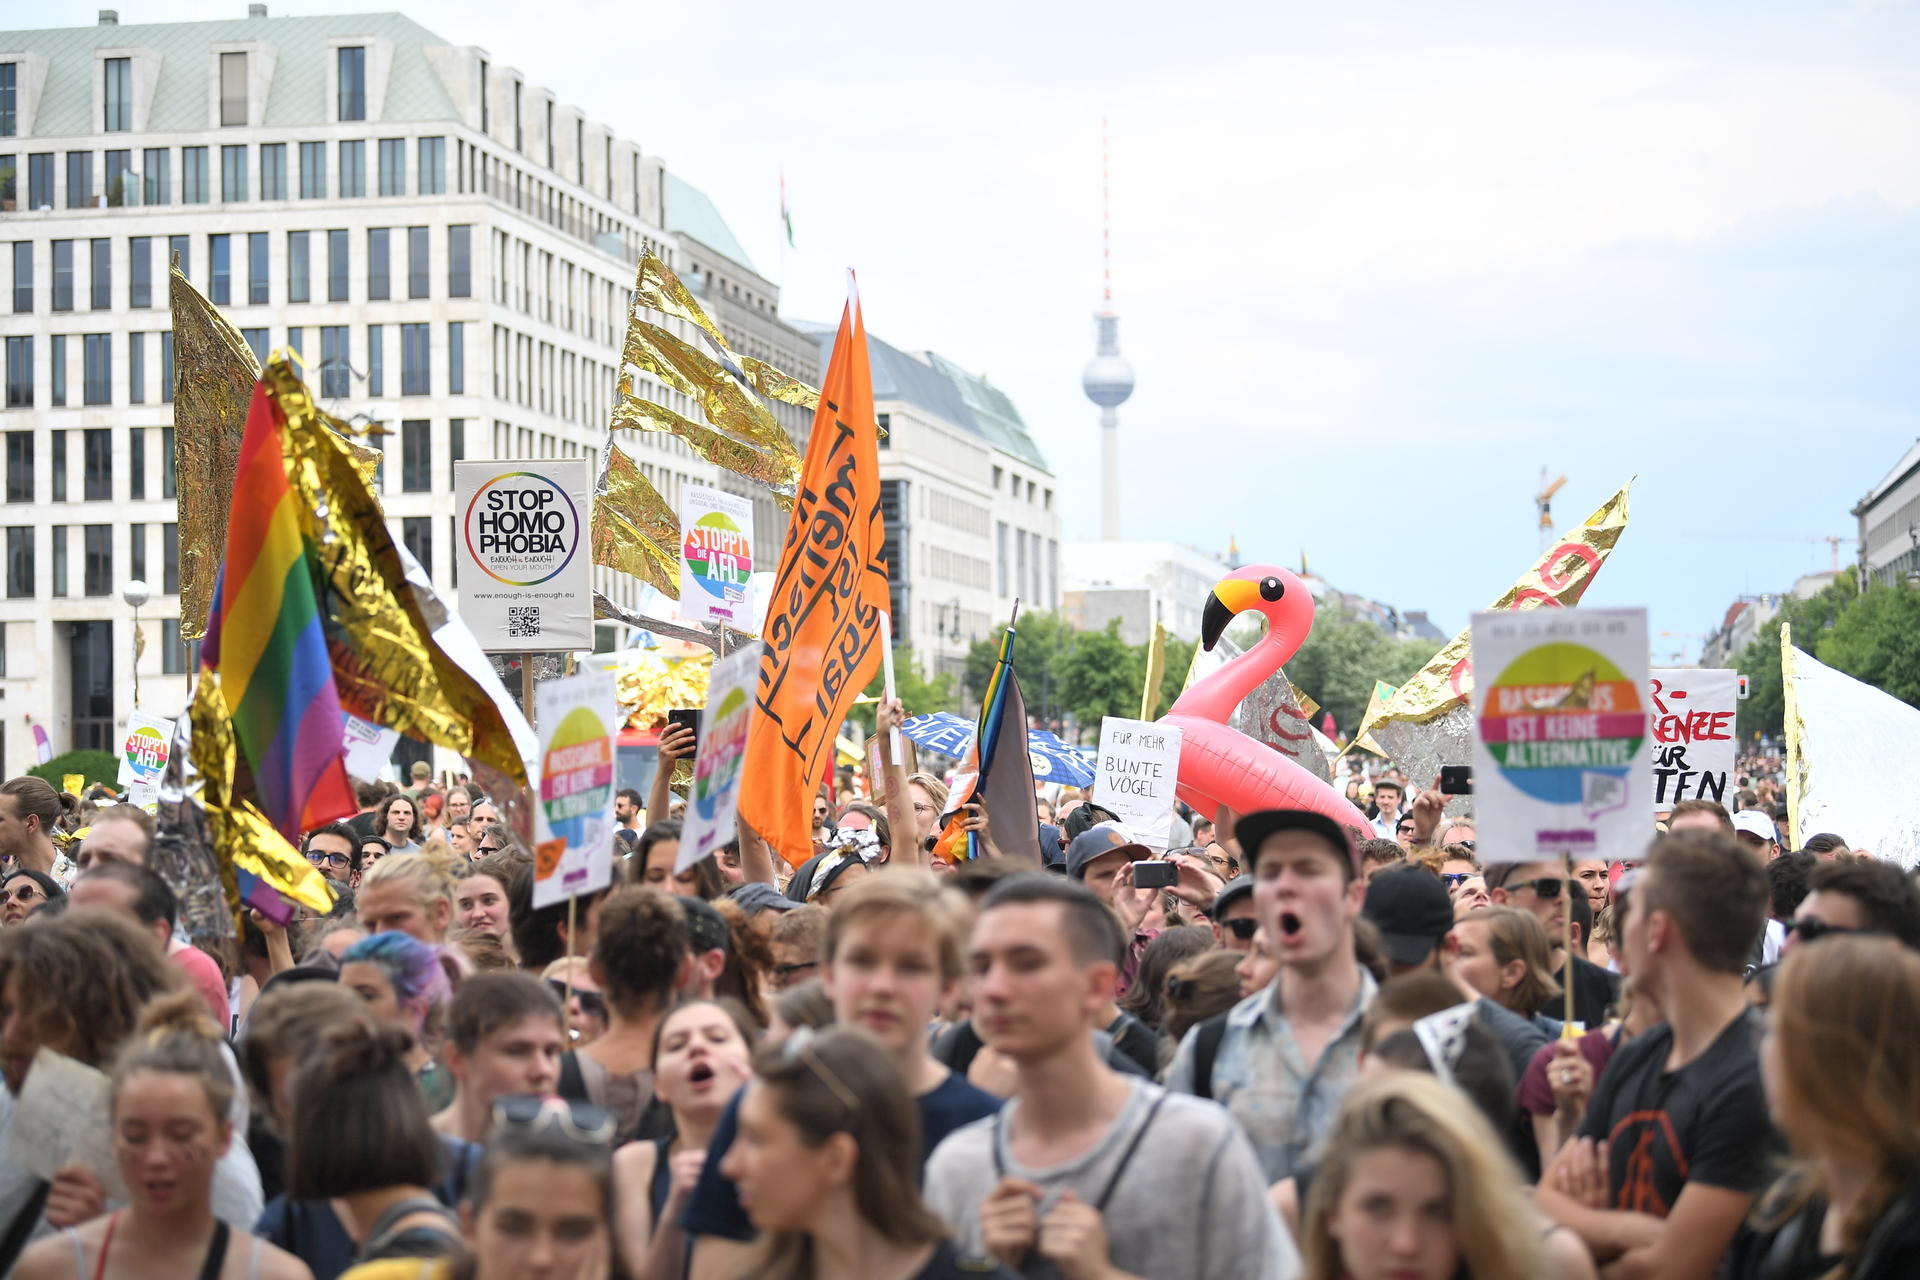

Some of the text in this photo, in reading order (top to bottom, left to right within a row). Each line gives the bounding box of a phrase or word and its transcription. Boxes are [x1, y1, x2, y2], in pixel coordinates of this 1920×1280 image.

[487, 490, 554, 511] STOP
[479, 511, 565, 534] HOMO
[480, 534, 566, 553] PHOBIA
[689, 525, 746, 557] STOPPT
[490, 555, 517, 564] ENOUGH
[697, 549, 707, 559] DIE
[707, 551, 738, 584] AFD
[473, 592, 575, 600] www.enough-is-enough.eu
[1507, 715, 1598, 741] IST KEINE
[129, 732, 164, 754] STOPPT
[1112, 730, 1165, 751] FÜR MEHR
[136, 748, 158, 769] AFD
[1504, 739, 1630, 769] ALTERNATIVE
[1105, 756, 1163, 778] BUNTE
[1110, 776, 1158, 798] VÖGEL
